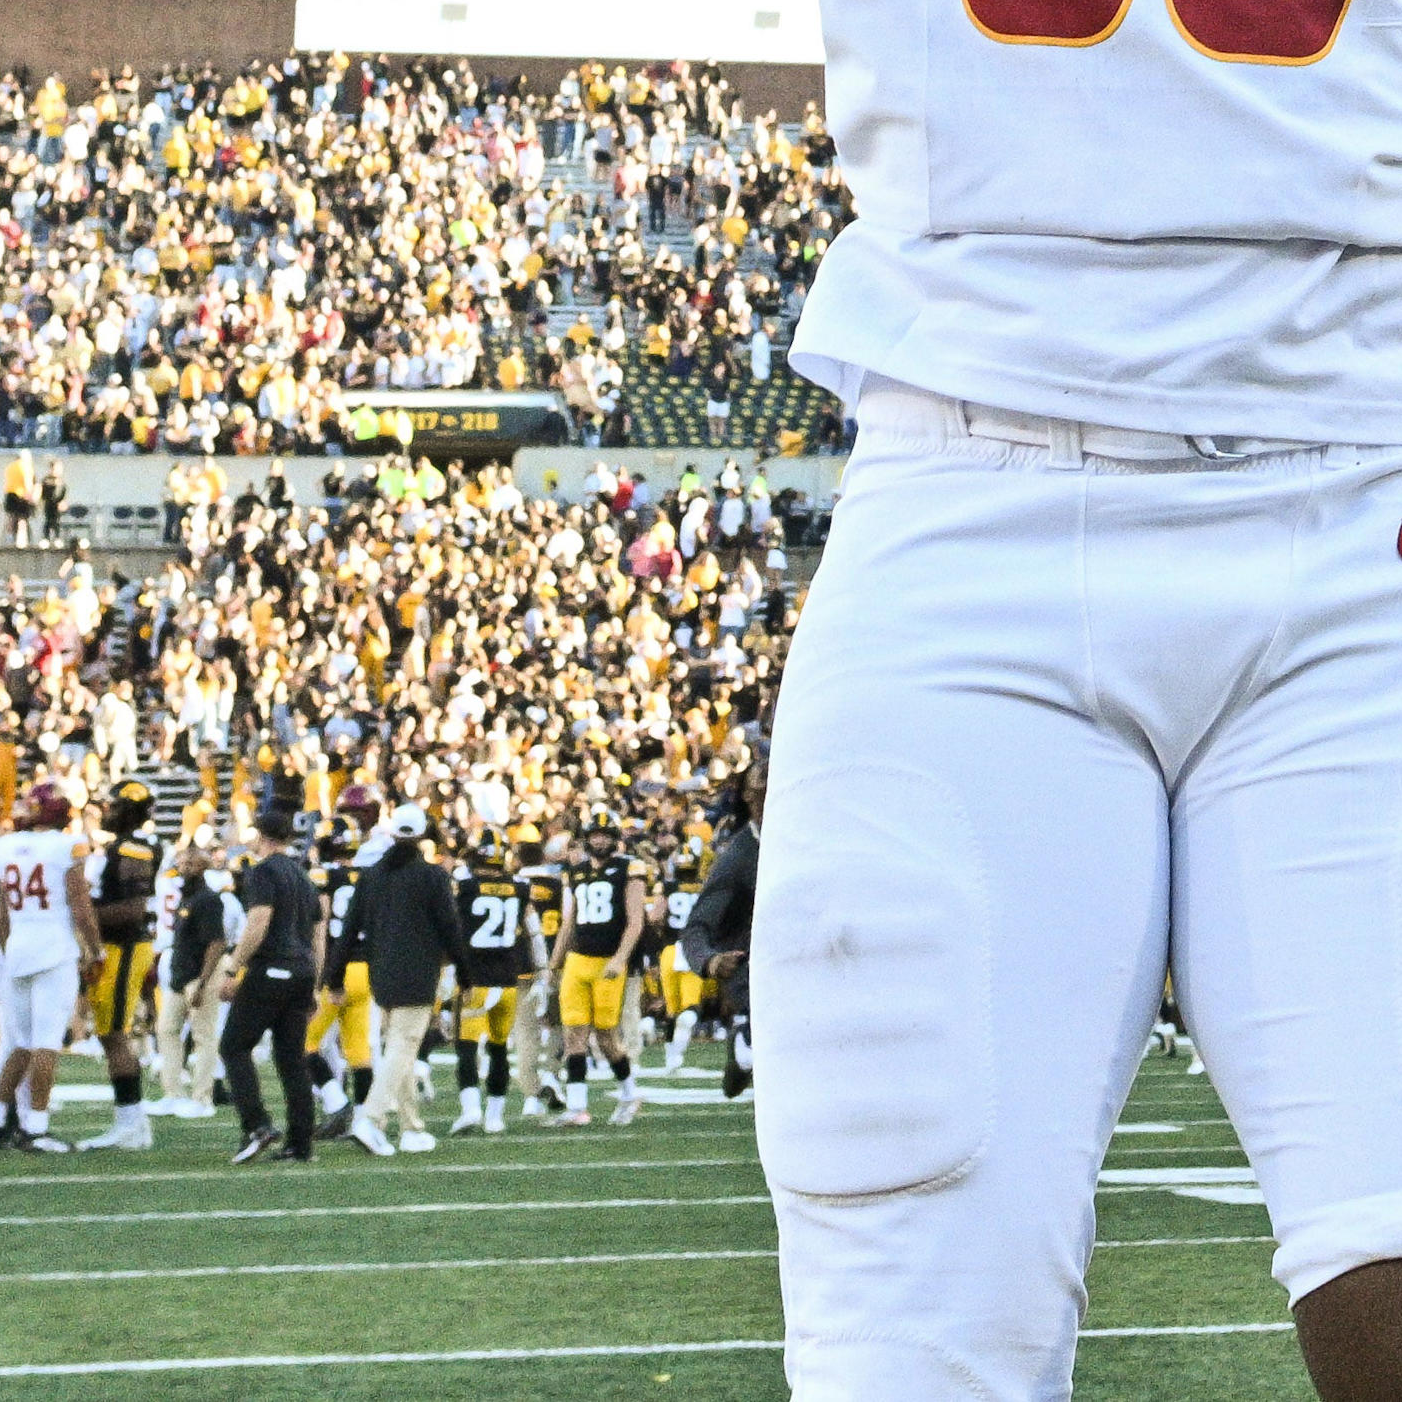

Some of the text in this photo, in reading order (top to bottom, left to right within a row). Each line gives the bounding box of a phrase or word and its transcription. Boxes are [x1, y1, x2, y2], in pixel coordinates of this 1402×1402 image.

[469, 896, 520, 948] 21
[573, 881, 614, 925] 18
[668, 891, 700, 930] 9
